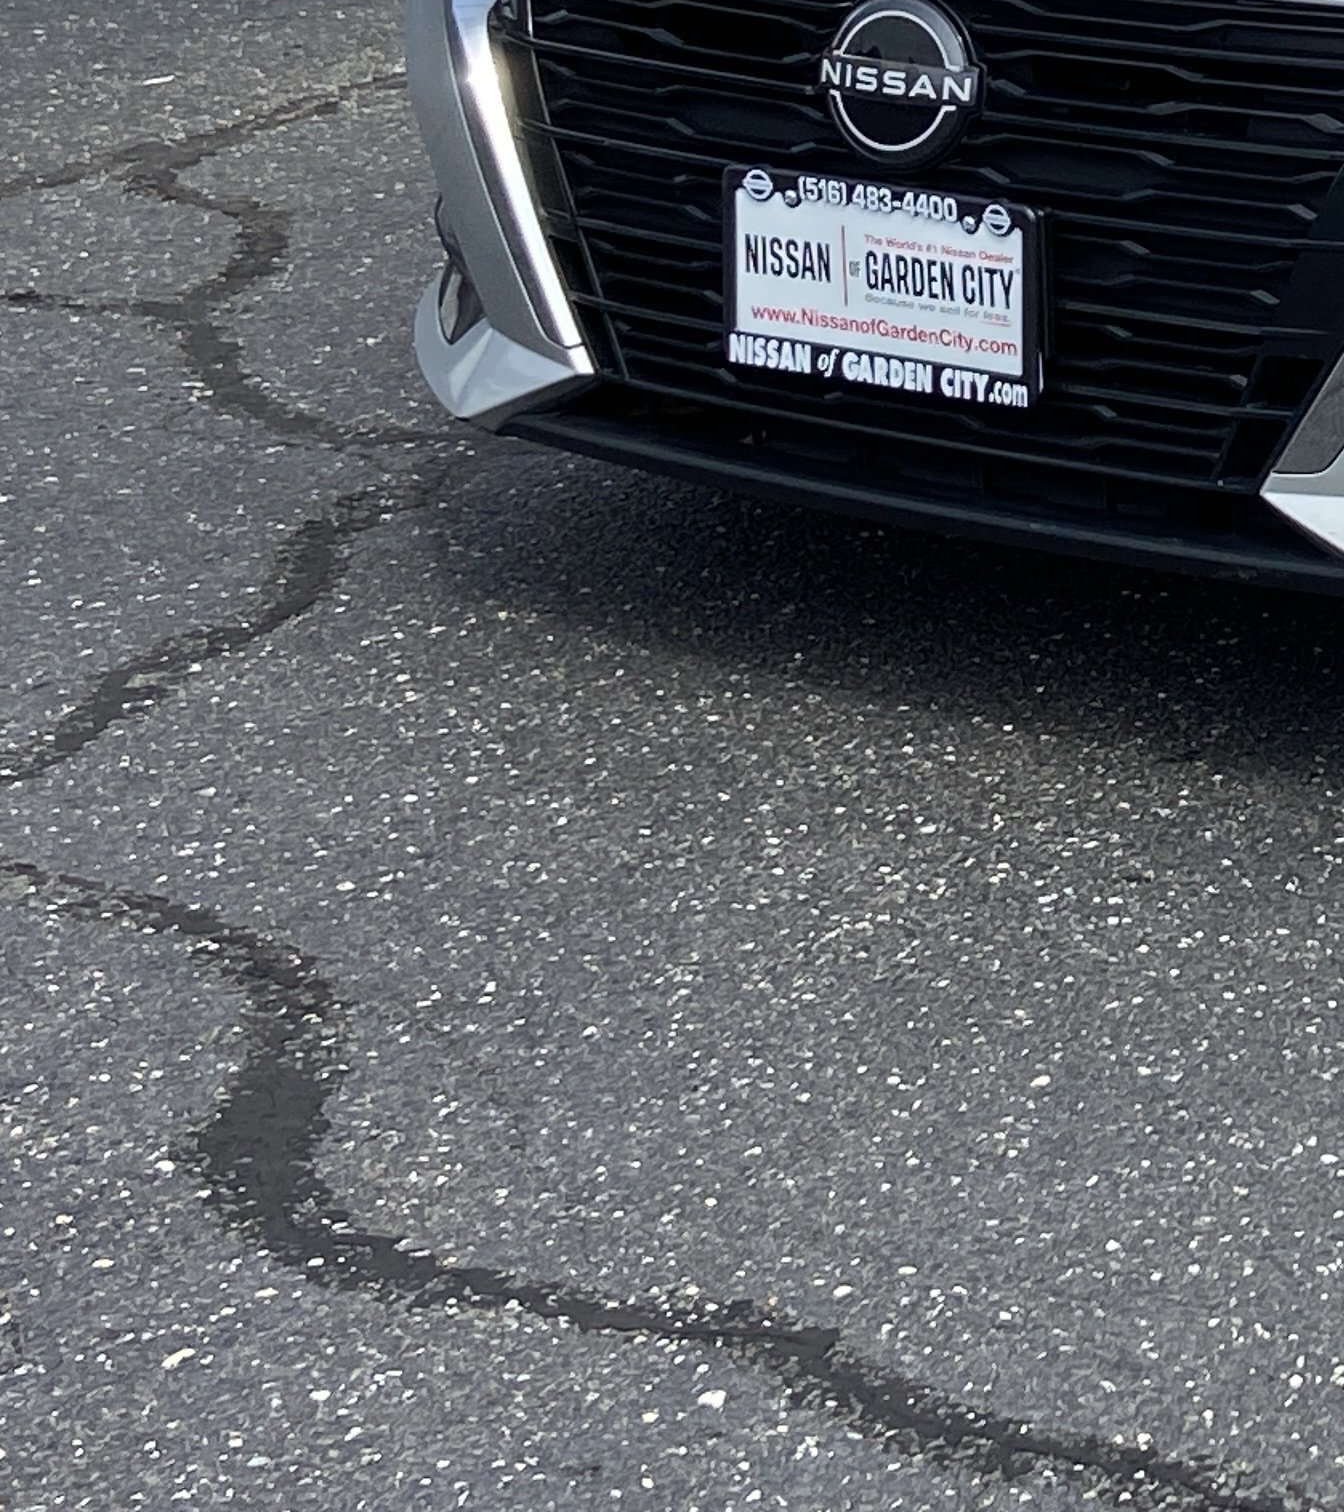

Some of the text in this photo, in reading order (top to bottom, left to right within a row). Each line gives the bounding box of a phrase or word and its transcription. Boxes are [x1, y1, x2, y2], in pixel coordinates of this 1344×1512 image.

[821, 58, 972, 102] NISSAN
[798, 175, 958, 222] (516) 483-4400
[744, 233, 831, 283] NISSAN
[865, 250, 955, 302] GARDEN
[961, 263, 1014, 310] CITY
[864, 233, 883, 246] The
[885, 236, 924, 252] World's
[941, 245, 976, 259] Nissan
[979, 250, 1014, 264] Dealer
[751, 305, 1018, 357] www.NissanofGardenCity.com
[728, 332, 812, 374] NISSAN
[817, 348, 840, 378] of
[841, 351, 933, 394] GARDEN
